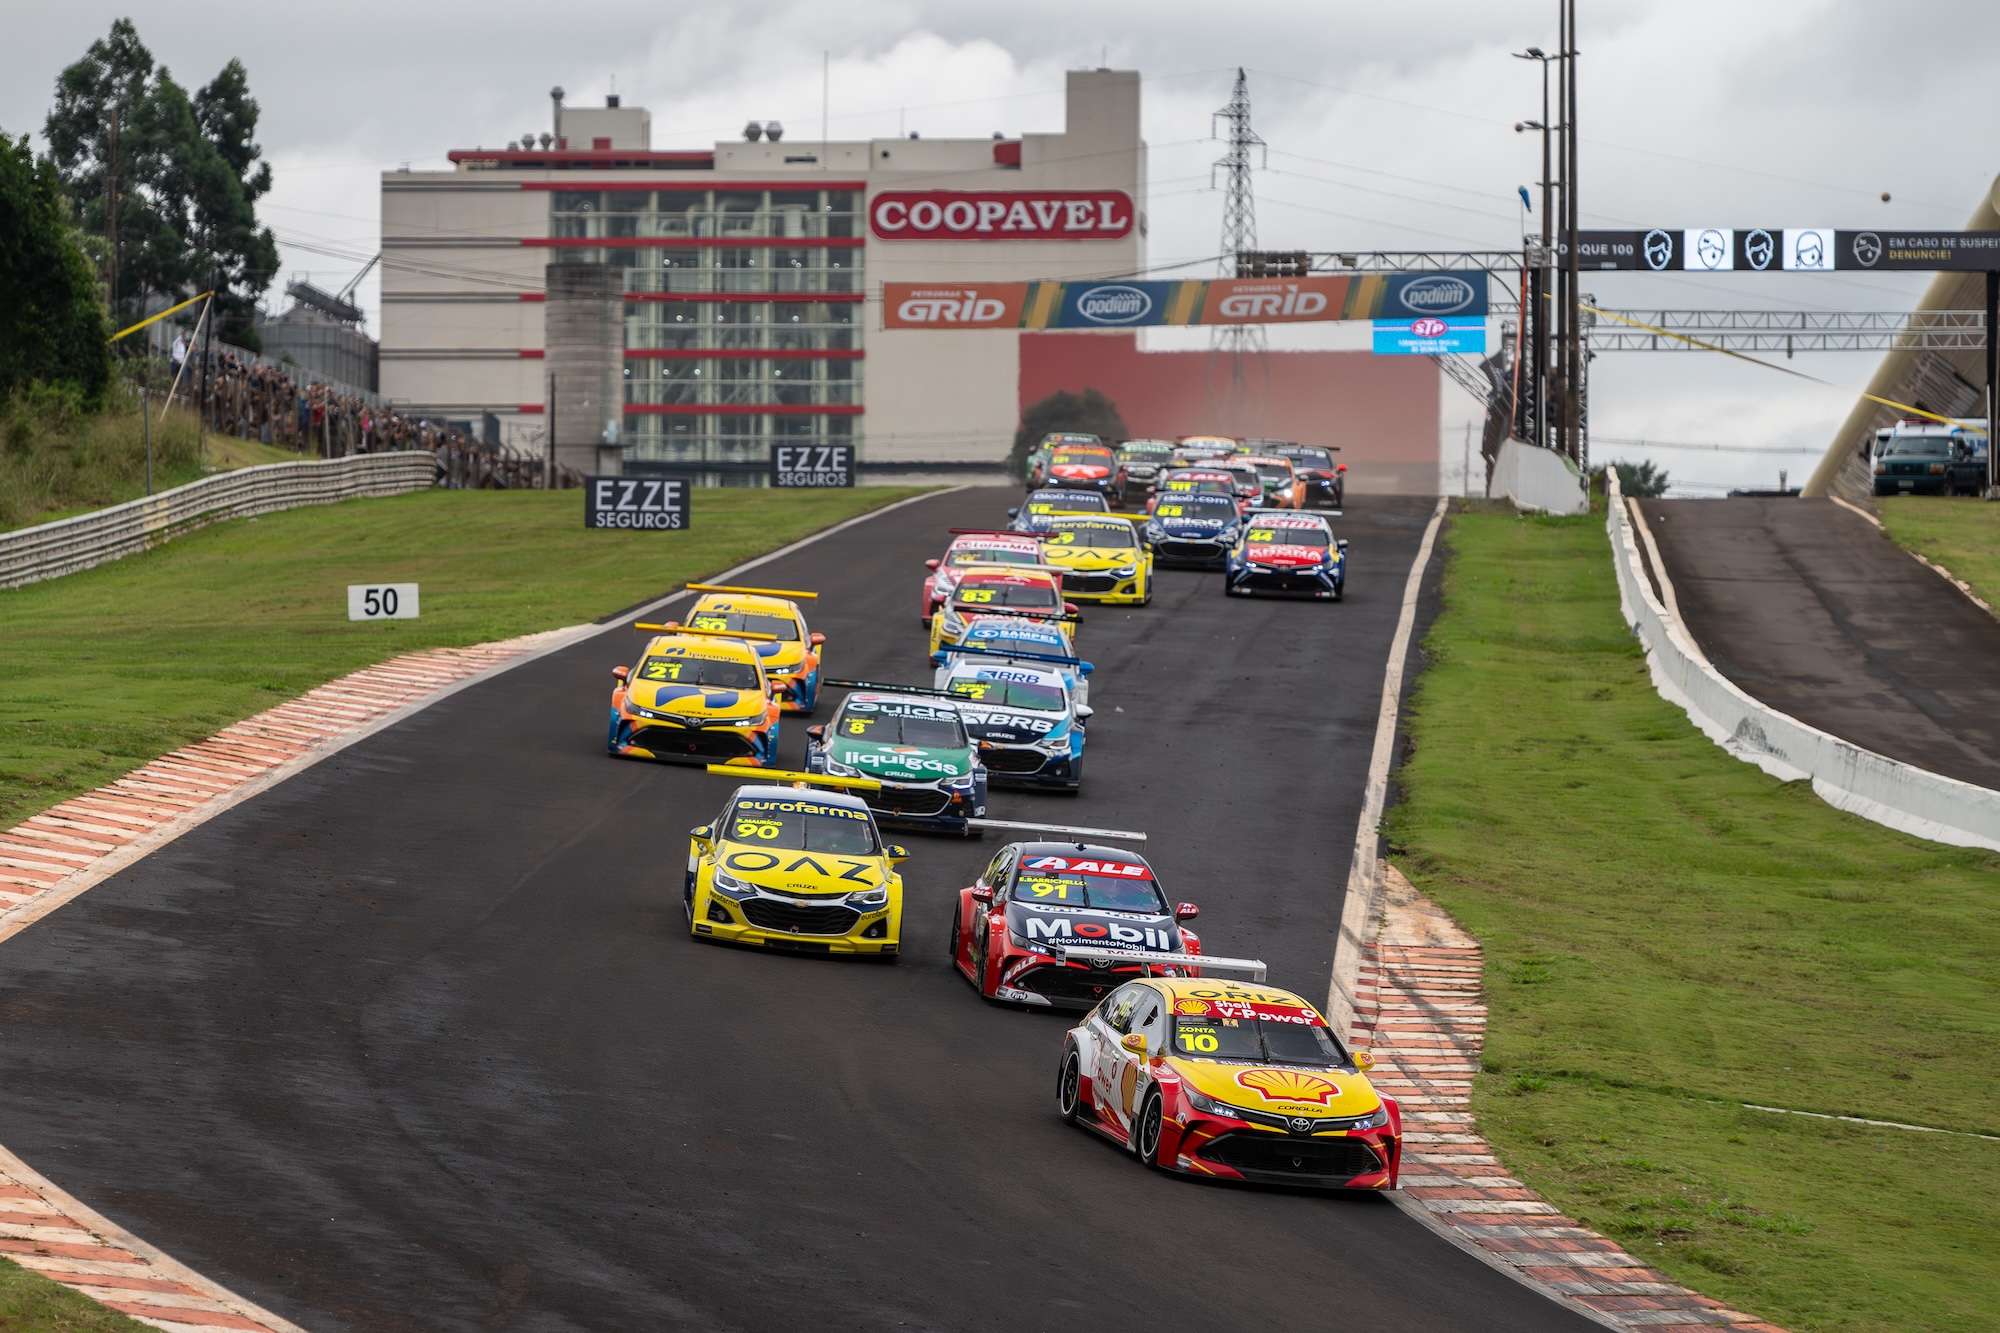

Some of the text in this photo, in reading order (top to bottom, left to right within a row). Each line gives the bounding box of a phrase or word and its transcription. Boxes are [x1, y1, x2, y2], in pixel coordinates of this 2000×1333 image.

[875, 200, 1128, 232] COOPAVEL
[1559, 243, 1634, 256] DQUE 100
[1889, 238, 1906, 248] EM
[1908, 238, 1939, 248] CASO
[1942, 238, 1957, 248] DE
[1889, 250, 1951, 260] DENUNCIE!
[1219, 284, 1328, 317] GRID
[1408, 286, 1464, 305] podium
[898, 290, 1006, 322] GRID
[1086, 296, 1142, 315] podium
[1415, 320, 1444, 335] STP
[777, 447, 847, 472] EZZE
[777, 472, 848, 487] SEGUROS
[595, 480, 682, 512] EZZE
[1157, 507, 1182, 517] 88
[595, 512, 682, 529] SEGUROS
[1052, 521, 1130, 532] eurofarma
[1247, 530, 1273, 541] 44
[364, 588, 398, 616] 50
[961, 591, 992, 602] 83
[734, 608, 781, 618] Ipiranga
[695, 620, 727, 631] 30
[1000, 630, 1057, 642] SAMPEL
[689, 652, 739, 663] Ipiranga
[647, 666, 681, 679] 21
[998, 671, 1040, 684] BRB
[847, 702, 958, 720] Guide
[849, 722, 866, 735] 8
[987, 712, 1054, 734] BRB
[845, 751, 959, 776] liquigás
[884, 770, 916, 779] CRUZE
[737, 801, 869, 821] eurofarma
[737, 824, 780, 839] 90
[1070, 861, 1145, 876] ALE
[786, 883, 819, 891] CRUZE
[1031, 883, 1068, 899] 91
[1026, 917, 1170, 951] Mobil
[1048, 937, 1146, 952] #MovimentoMobil
[1013, 955, 1038, 976] ALE
[1214, 1000, 1251, 1010] Shell
[1216, 1007, 1313, 1025] V-Power
[1178, 1026, 1217, 1034] ZONTA
[1179, 1033, 1219, 1052] 10
[1277, 1105, 1323, 1114] COROLLA
